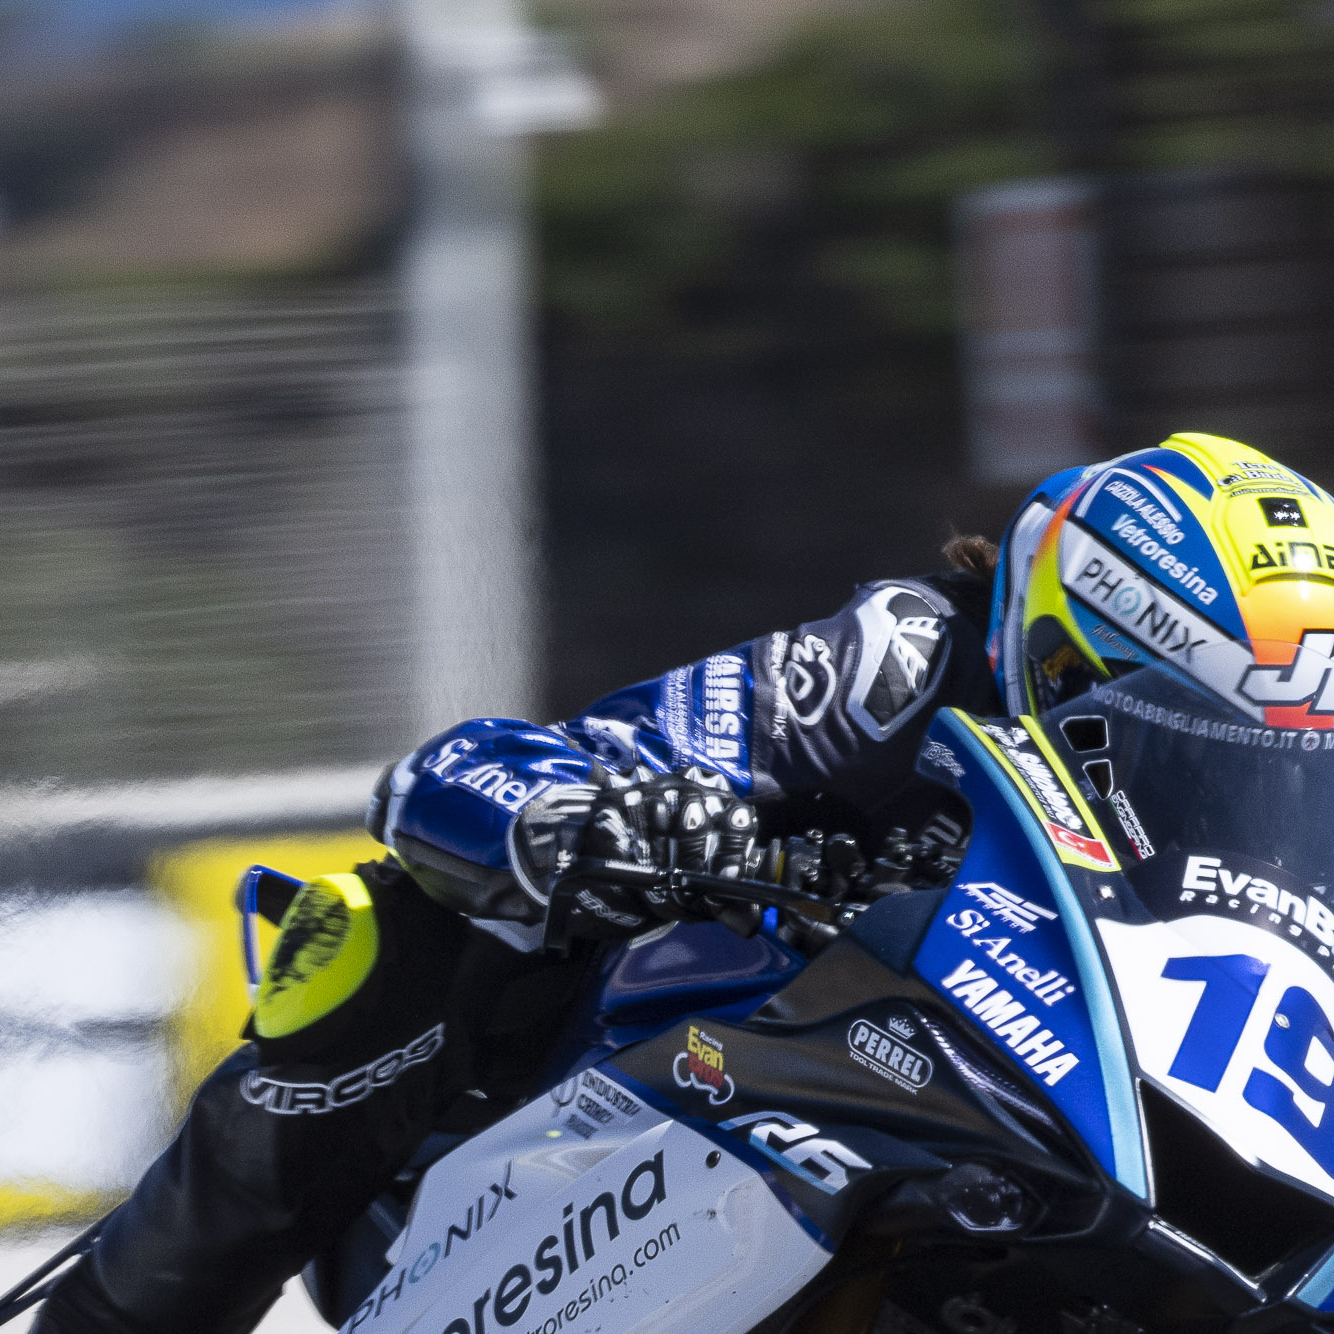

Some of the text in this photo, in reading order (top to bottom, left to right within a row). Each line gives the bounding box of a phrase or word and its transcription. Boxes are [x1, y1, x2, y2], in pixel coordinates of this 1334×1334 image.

[1111, 513, 1218, 605] Vetroresina
[1076, 557, 1208, 663] PHONIX
[946, 909, 1076, 1007] Si Anelli
[1179, 890, 1303, 937] Racing
[688, 1025, 724, 1072] Evan
[853, 1024, 924, 1083] PERREL
[940, 959, 1080, 1087] YAMAHA
